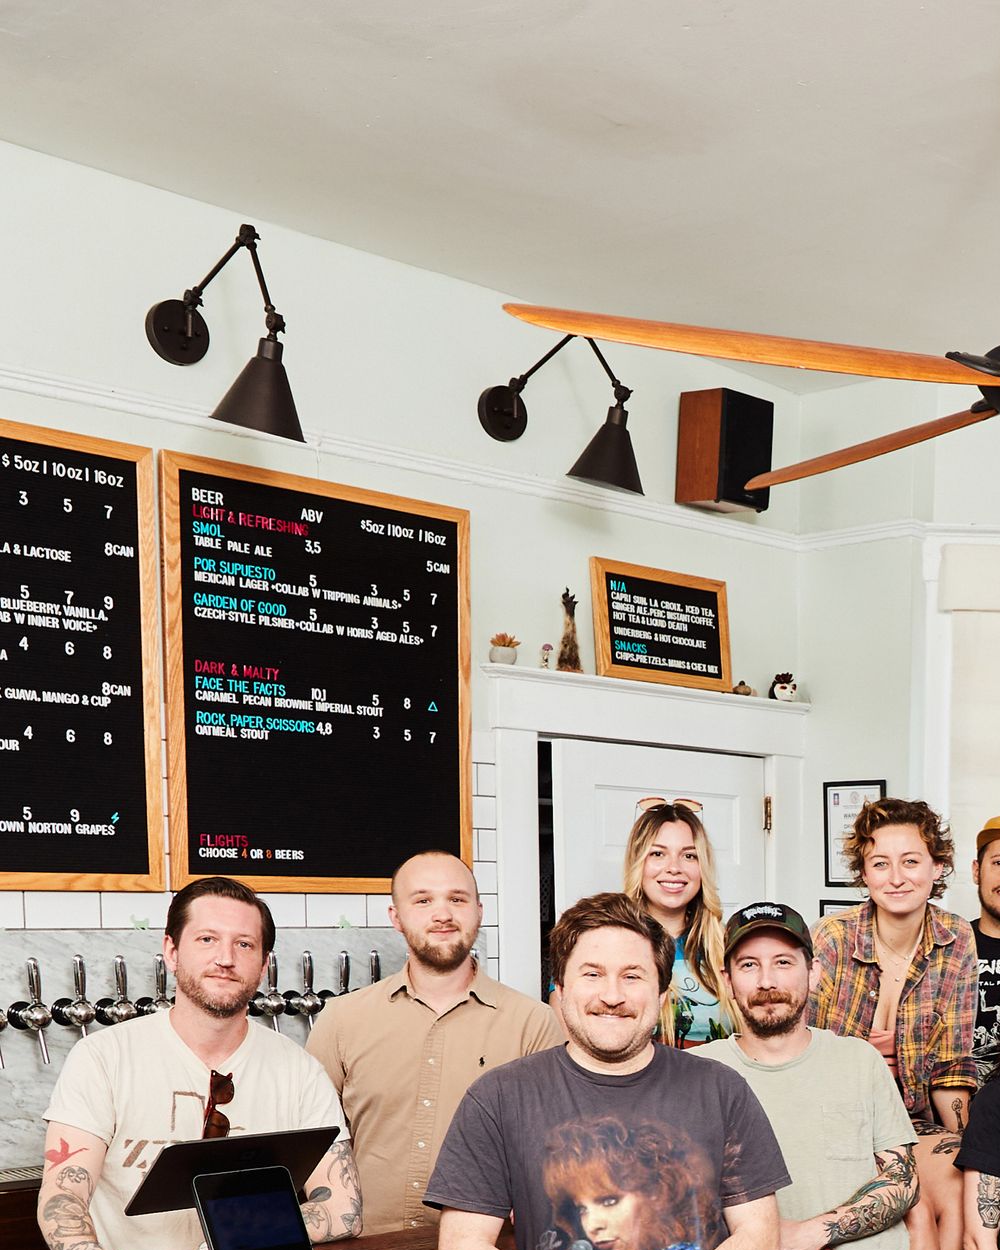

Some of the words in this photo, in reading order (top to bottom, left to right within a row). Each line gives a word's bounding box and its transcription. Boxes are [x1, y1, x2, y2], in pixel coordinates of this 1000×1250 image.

[19, 491, 28, 506] 3
[63, 499, 73, 513] 5
[104, 505, 113, 519] 7
[192, 488, 224, 506] BEER
[301, 508, 323, 523] ABV
[193, 504, 225, 521] LIGHT
[228, 511, 236, 524] &
[239, 512, 309, 537] REFRESHING
[193, 521, 225, 537] SMOL
[13, 544, 21, 555] &
[23, 545, 72, 562] LACTOSE
[193, 535, 222, 549] TABLE
[227, 541, 250, 554] PALE
[254, 545, 272, 557] ALE
[194, 557, 216, 572] POR
[220, 561, 276, 580] SUPUESTO
[310, 575, 317, 587] 5
[194, 571, 235, 586] MEXICAN
[240, 577, 269, 591] LAGER
[312, 588, 320, 598] W
[322, 590, 360, 604] TRIPPING
[371, 584, 378, 596] 3
[403, 590, 410, 601] 5
[430, 593, 437, 605] 7
[611, 580, 627, 593] N/A
[20, 585, 30, 599] 5
[64, 591, 74, 605] 7
[104, 596, 114, 610] 9
[194, 592, 237, 610] GARDEN
[240, 599, 255, 612] OF
[258, 601, 287, 616] GOOD
[310, 608, 317, 621] 5
[611, 591, 631, 603] CAPRI
[650, 598, 658, 608] LA
[686, 605, 700, 615] ICED
[14, 612, 25, 624] W
[28, 614, 60, 629] INNER
[612, 601, 635, 613] GINGER
[667, 611, 690, 623] INSTANT
[613, 611, 626, 621] HOT
[628, 613, 640, 624] TEA
[646, 617, 667, 628] LIQUID
[668, 621, 688, 632] DEATH
[336, 625, 344, 636] W
[347, 627, 373, 639] HORUS
[376, 631, 398, 642] AGED
[371, 617, 378, 629] 3
[403, 622, 410, 633] 5
[430, 625, 437, 637] 7
[19, 636, 29, 650] 4
[64, 642, 75, 655] 6
[103, 646, 112, 660] 8
[615, 640, 647, 654] SNACKS
[660, 634, 671, 644] HOT
[672, 636, 707, 649] CHOCOLATE
[195, 660, 225, 675] DARK
[231, 664, 239, 676] &
[244, 665, 279, 681] MALTY
[691, 662, 706, 672] CHEX
[42, 691, 79, 704] MANGO
[82, 695, 89, 706] &
[91, 696, 111, 707] CUP
[195, 676, 224, 691] FACE
[227, 679, 249, 694] THE
[254, 682, 286, 697] FACTS
[372, 694, 379, 706] 5
[404, 698, 411, 709] 8
[195, 690, 239, 704] CARAMEL
[243, 694, 272, 707] PECAN
[274, 697, 313, 710] BROWNIE
[315, 702, 355, 715] IMPERIAL
[357, 705, 384, 717] STOUT
[24, 726, 33, 740] 4
[66, 729, 76, 743] 6
[104, 732, 112, 746] 8
[195, 725, 238, 738] OATMEAL
[240, 728, 270, 740] STOUT
[266, 718, 315, 733] SCISSORS
[373, 727, 380, 739] 3
[404, 729, 411, 741] 5
[429, 732, 436, 744] 7
[23, 806, 32, 820] 5
[70, 809, 80, 822] 9
[28, 822, 72, 834] NORTON
[75, 824, 115, 836] GRAPES
[200, 834, 248, 847] FLIGHTS
[199, 848, 238, 858] CHOOSE
[242, 849, 247, 858] 4
[250, 849, 263, 859] OR
[266, 850, 272, 859] 8
[275, 850, 304, 860] BEERS
